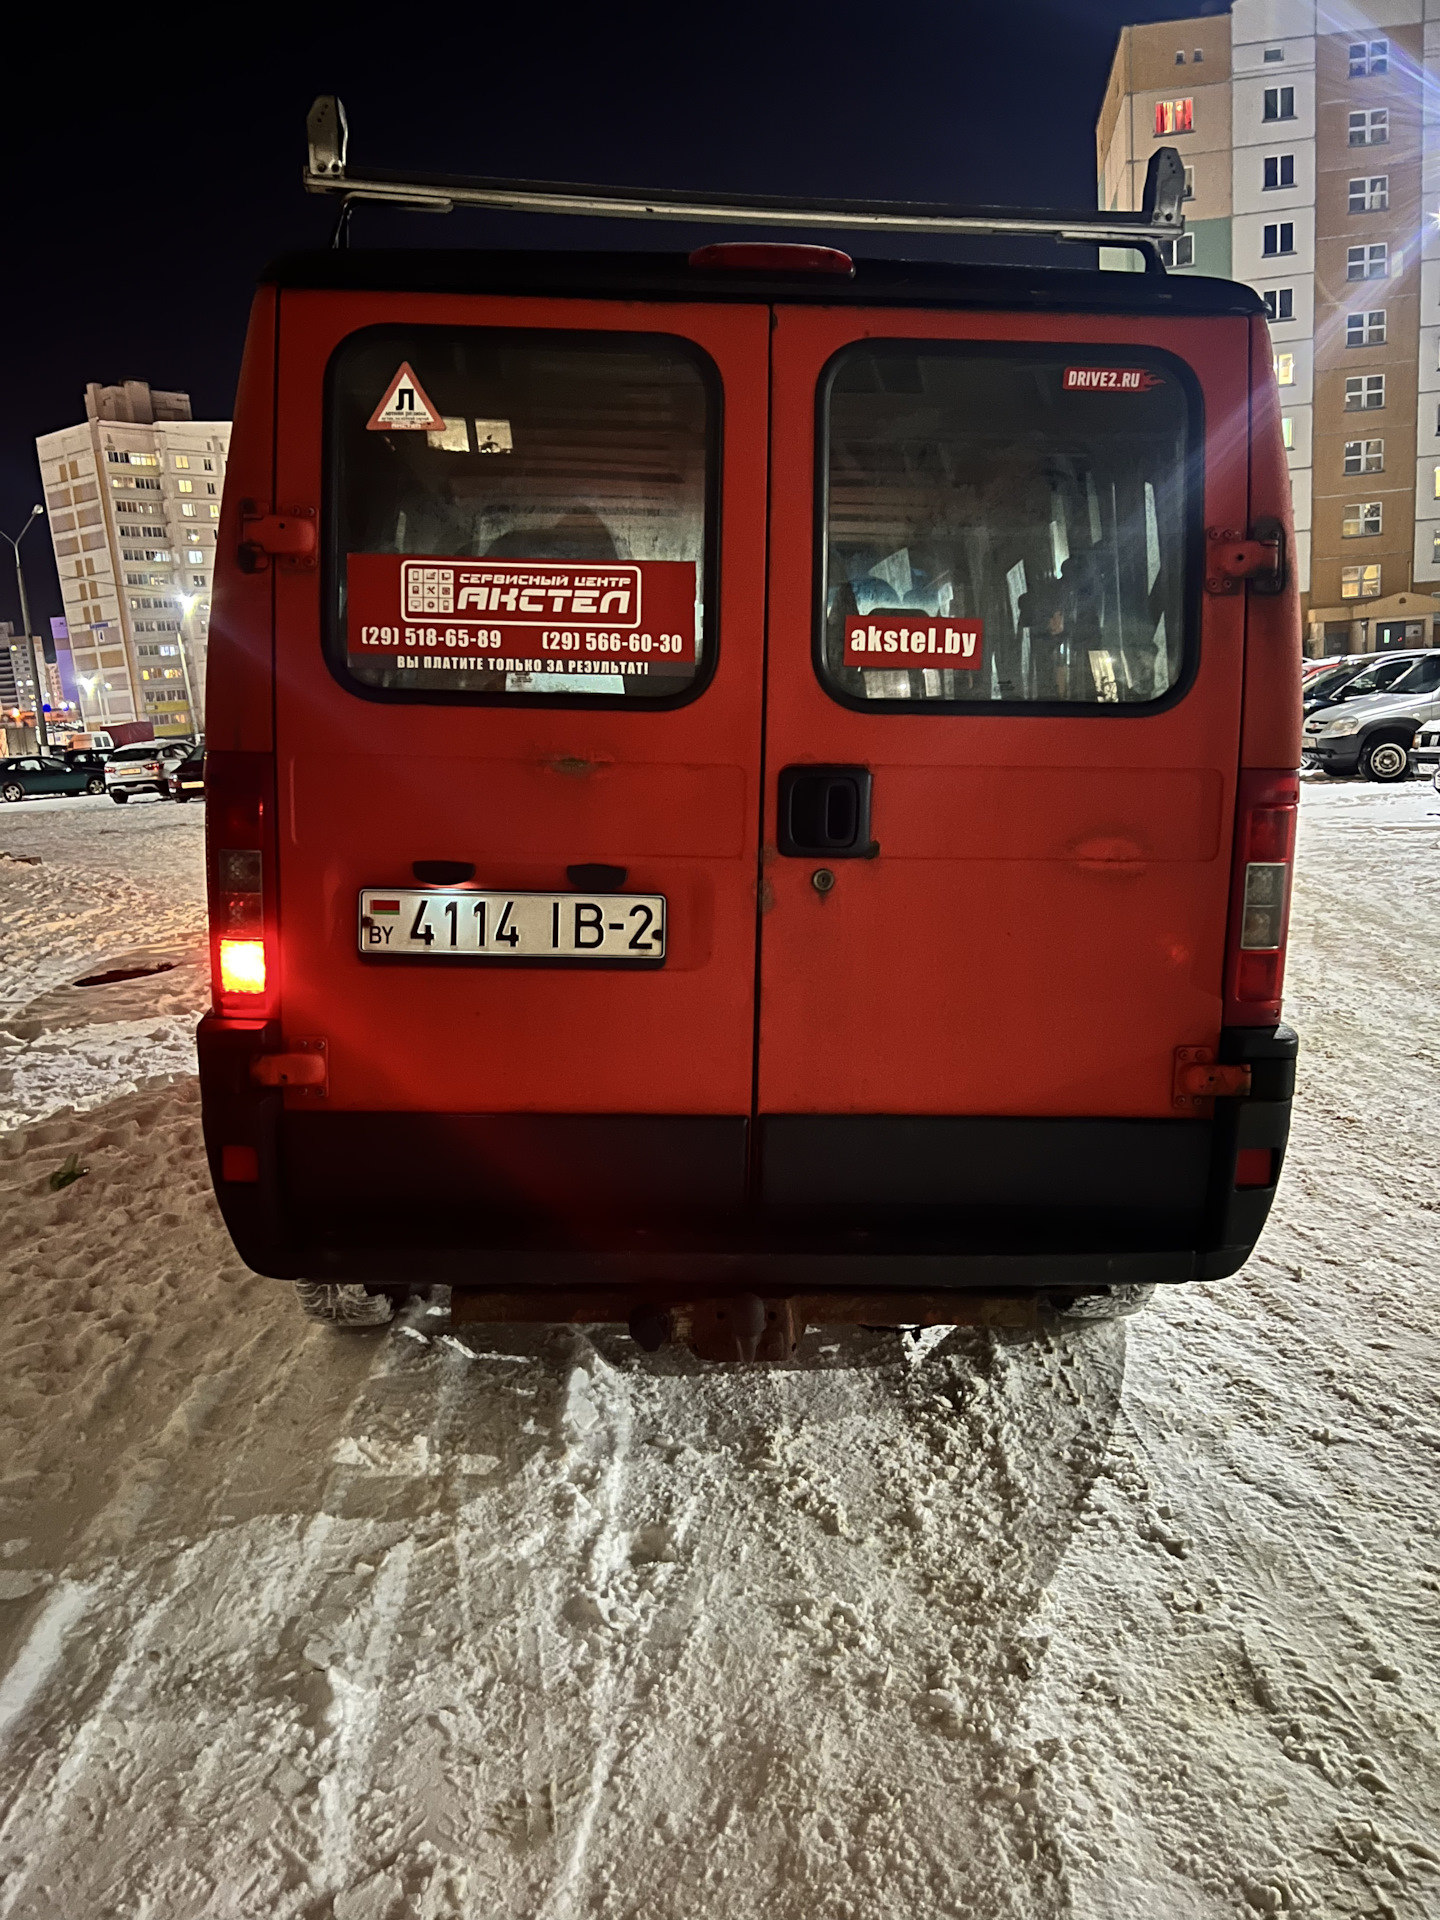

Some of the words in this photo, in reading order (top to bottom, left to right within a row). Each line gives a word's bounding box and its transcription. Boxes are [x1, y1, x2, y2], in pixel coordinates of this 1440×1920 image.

[1068, 370, 1141, 388] DRIVE2.RU
[395, 388, 415, 411] Л
[459, 573, 569, 586] СЕРВИСНЫЙ
[574, 576, 631, 587] ЦЕНТР
[457, 586, 631, 614] АКСТЕЛ
[361, 626, 400, 646] (29)
[405, 627, 502, 649] 518-65-89
[541, 631, 580, 651] (29)
[585, 632, 683, 654] 566-60-30
[850, 625, 977, 657] akstel.by
[397, 655, 419, 669] ВЫ
[423, 656, 484, 670] ПЛАТИТЕ
[488, 658, 542, 672] ТОЛЬКО
[546, 659, 564, 673] ЗА
[568, 660, 649, 675] РЕЗУЛЬТАТ!
[369, 925, 394, 945] BY
[410, 900, 520, 947] 4114
[551, 902, 654, 950] IB-2
